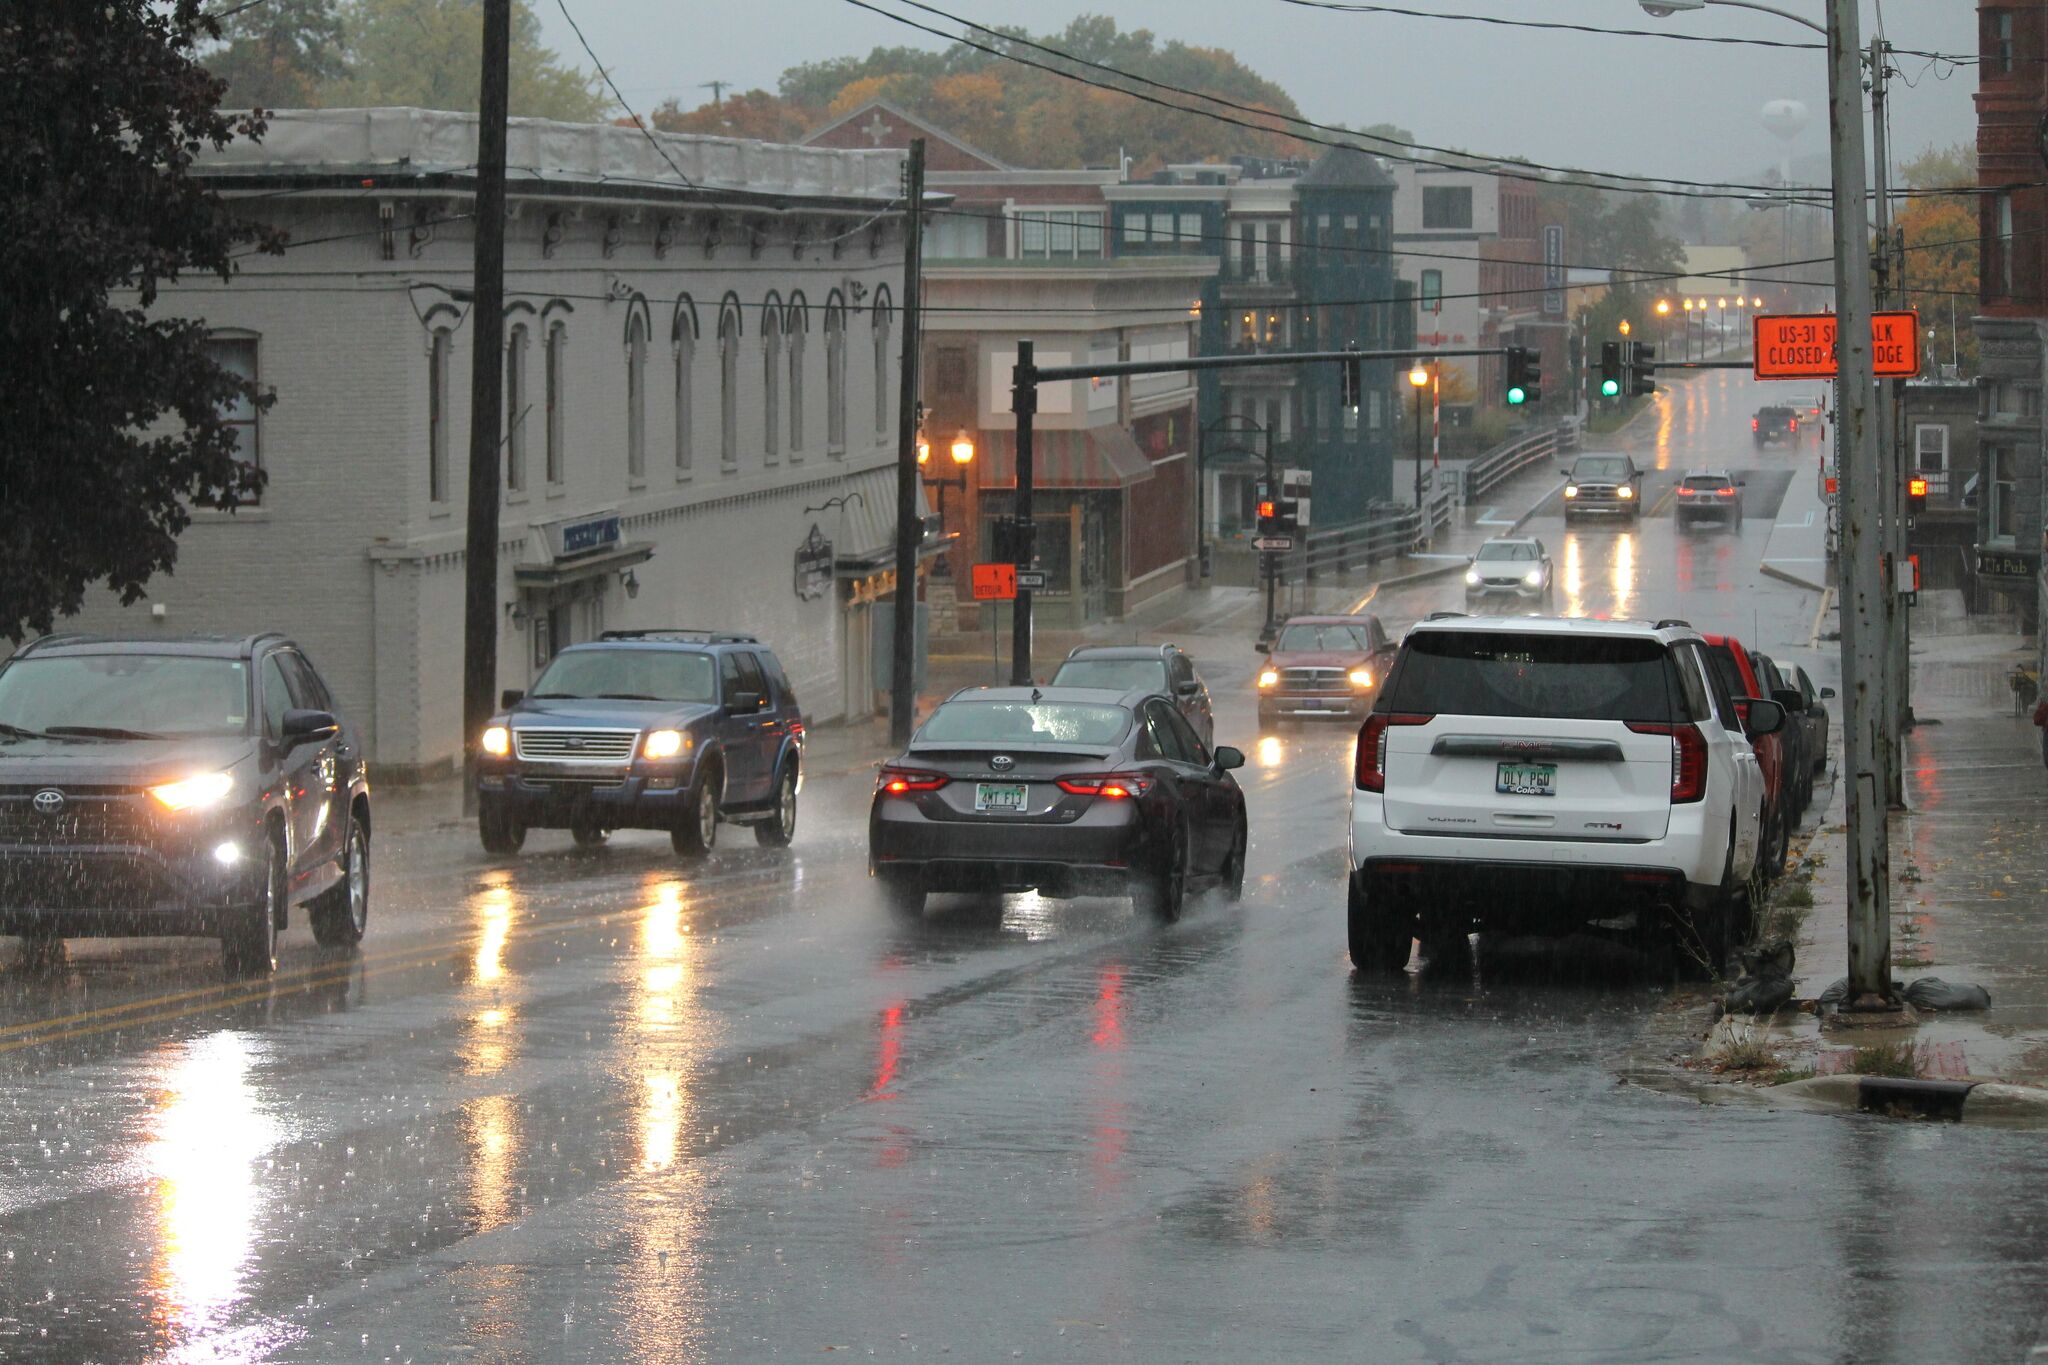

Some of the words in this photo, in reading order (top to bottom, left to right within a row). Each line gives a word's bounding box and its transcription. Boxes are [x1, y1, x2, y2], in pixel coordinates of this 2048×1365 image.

[1778, 325, 1816, 343] US-31
[1823, 324, 1893, 342] SILK
[1769, 346, 1822, 364] CLOSED
[2003, 559, 2027, 573] Pub
[975, 584, 1002, 596] DETOUR
[1502, 740, 1552, 750] GMC
